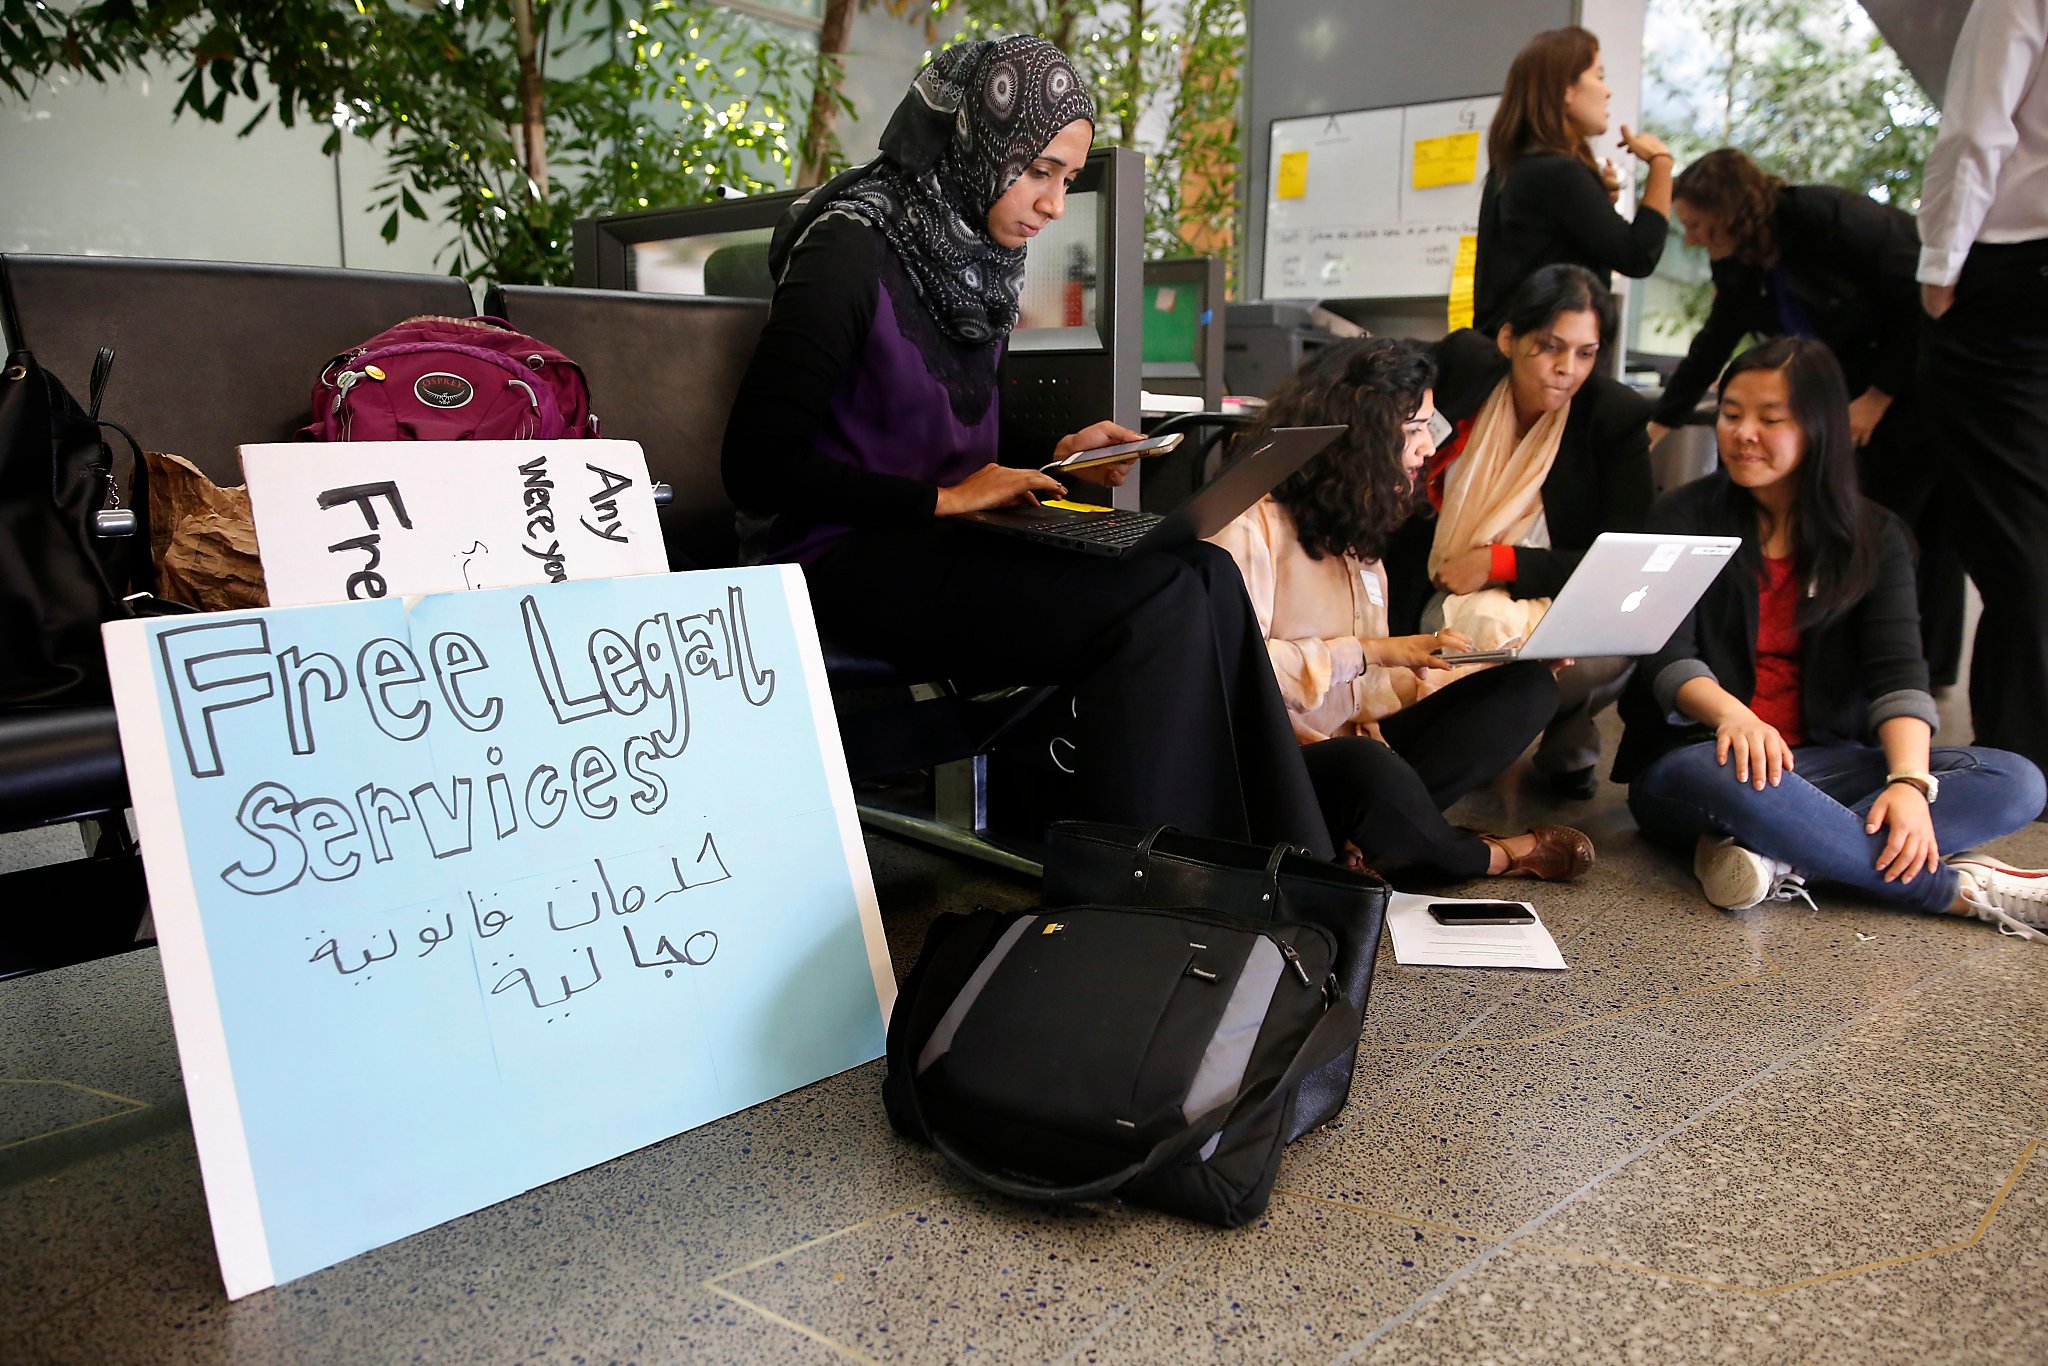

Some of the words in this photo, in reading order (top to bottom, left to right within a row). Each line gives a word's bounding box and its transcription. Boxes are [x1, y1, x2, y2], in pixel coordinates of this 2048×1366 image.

[422, 376, 465, 389] OSPREY
[316, 480, 413, 599] Fre
[579, 462, 633, 543] Any
[157, 617, 503, 777] Free
[521, 586, 775, 757] Legal
[221, 735, 670, 895] Services
